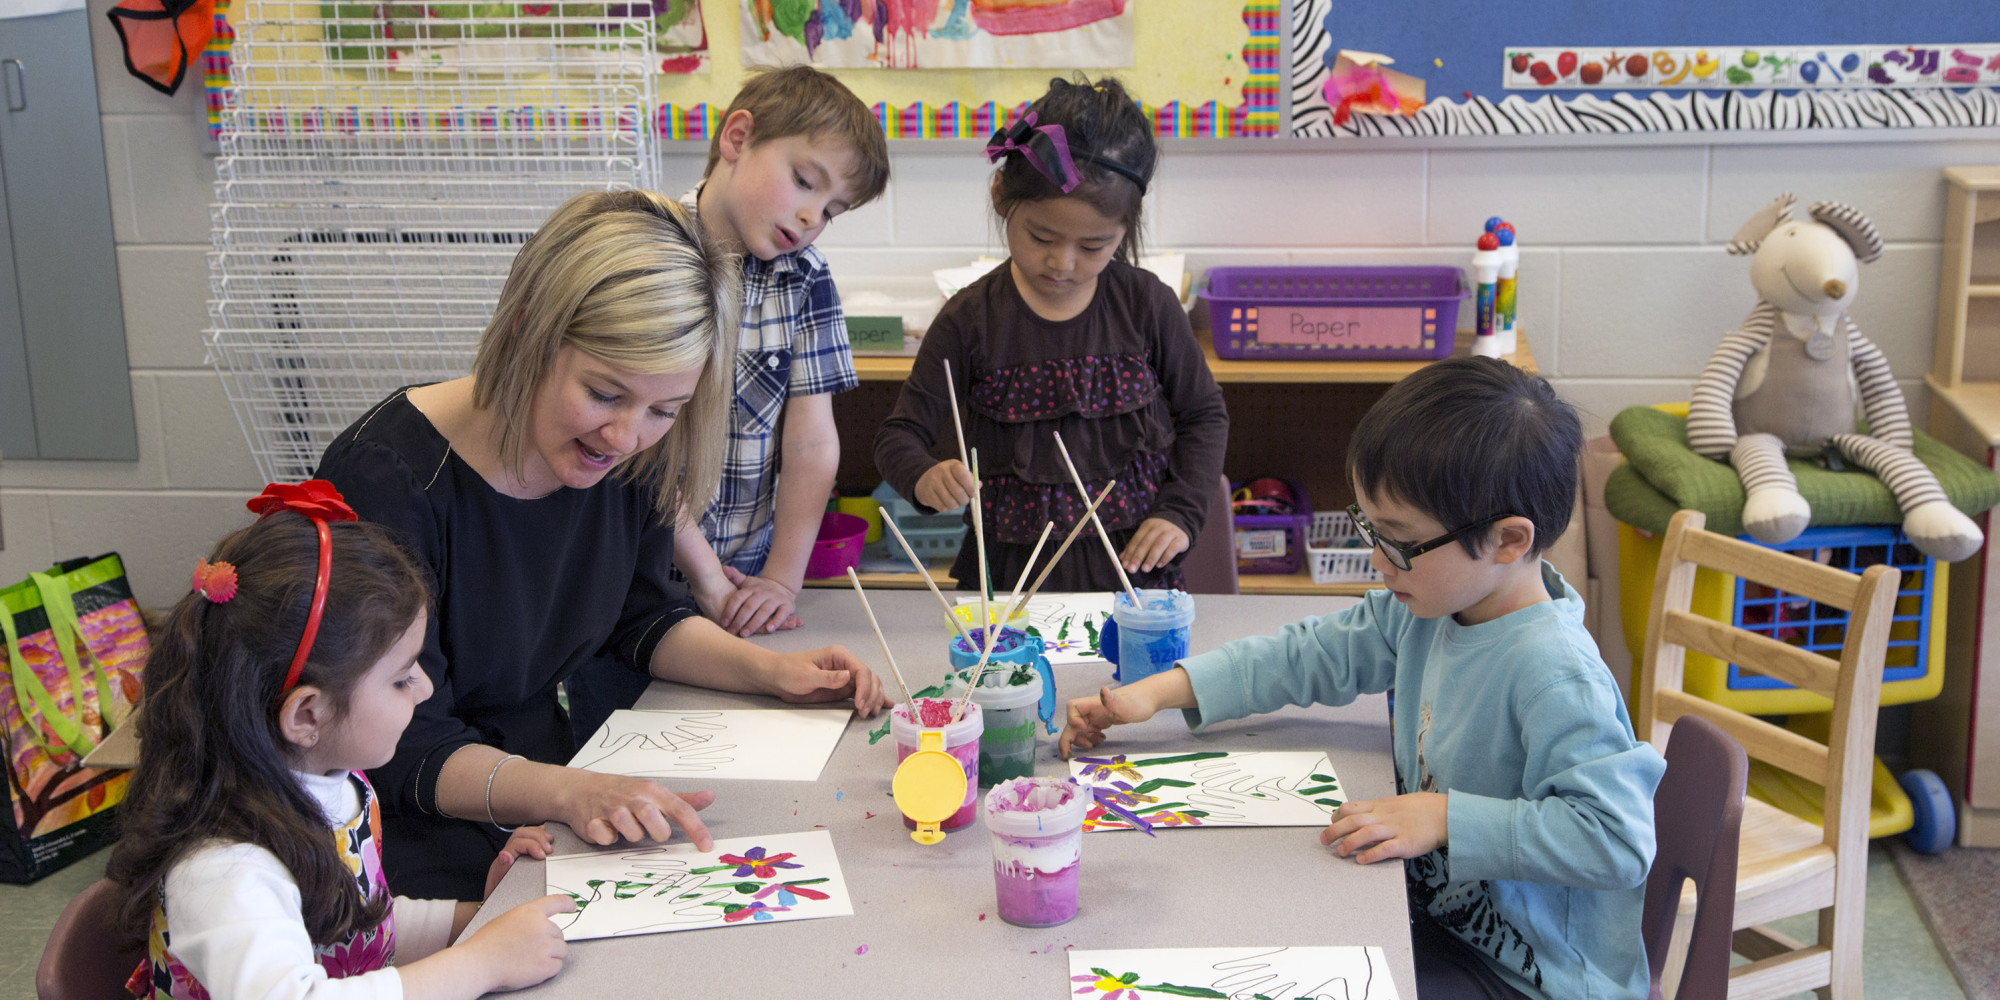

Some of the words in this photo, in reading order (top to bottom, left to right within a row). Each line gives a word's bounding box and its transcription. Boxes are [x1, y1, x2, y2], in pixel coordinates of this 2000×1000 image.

[848, 329, 891, 347] aper
[1290, 312, 1361, 341] Paper
[1150, 640, 1186, 664] azul
[984, 718, 1036, 745] verde
